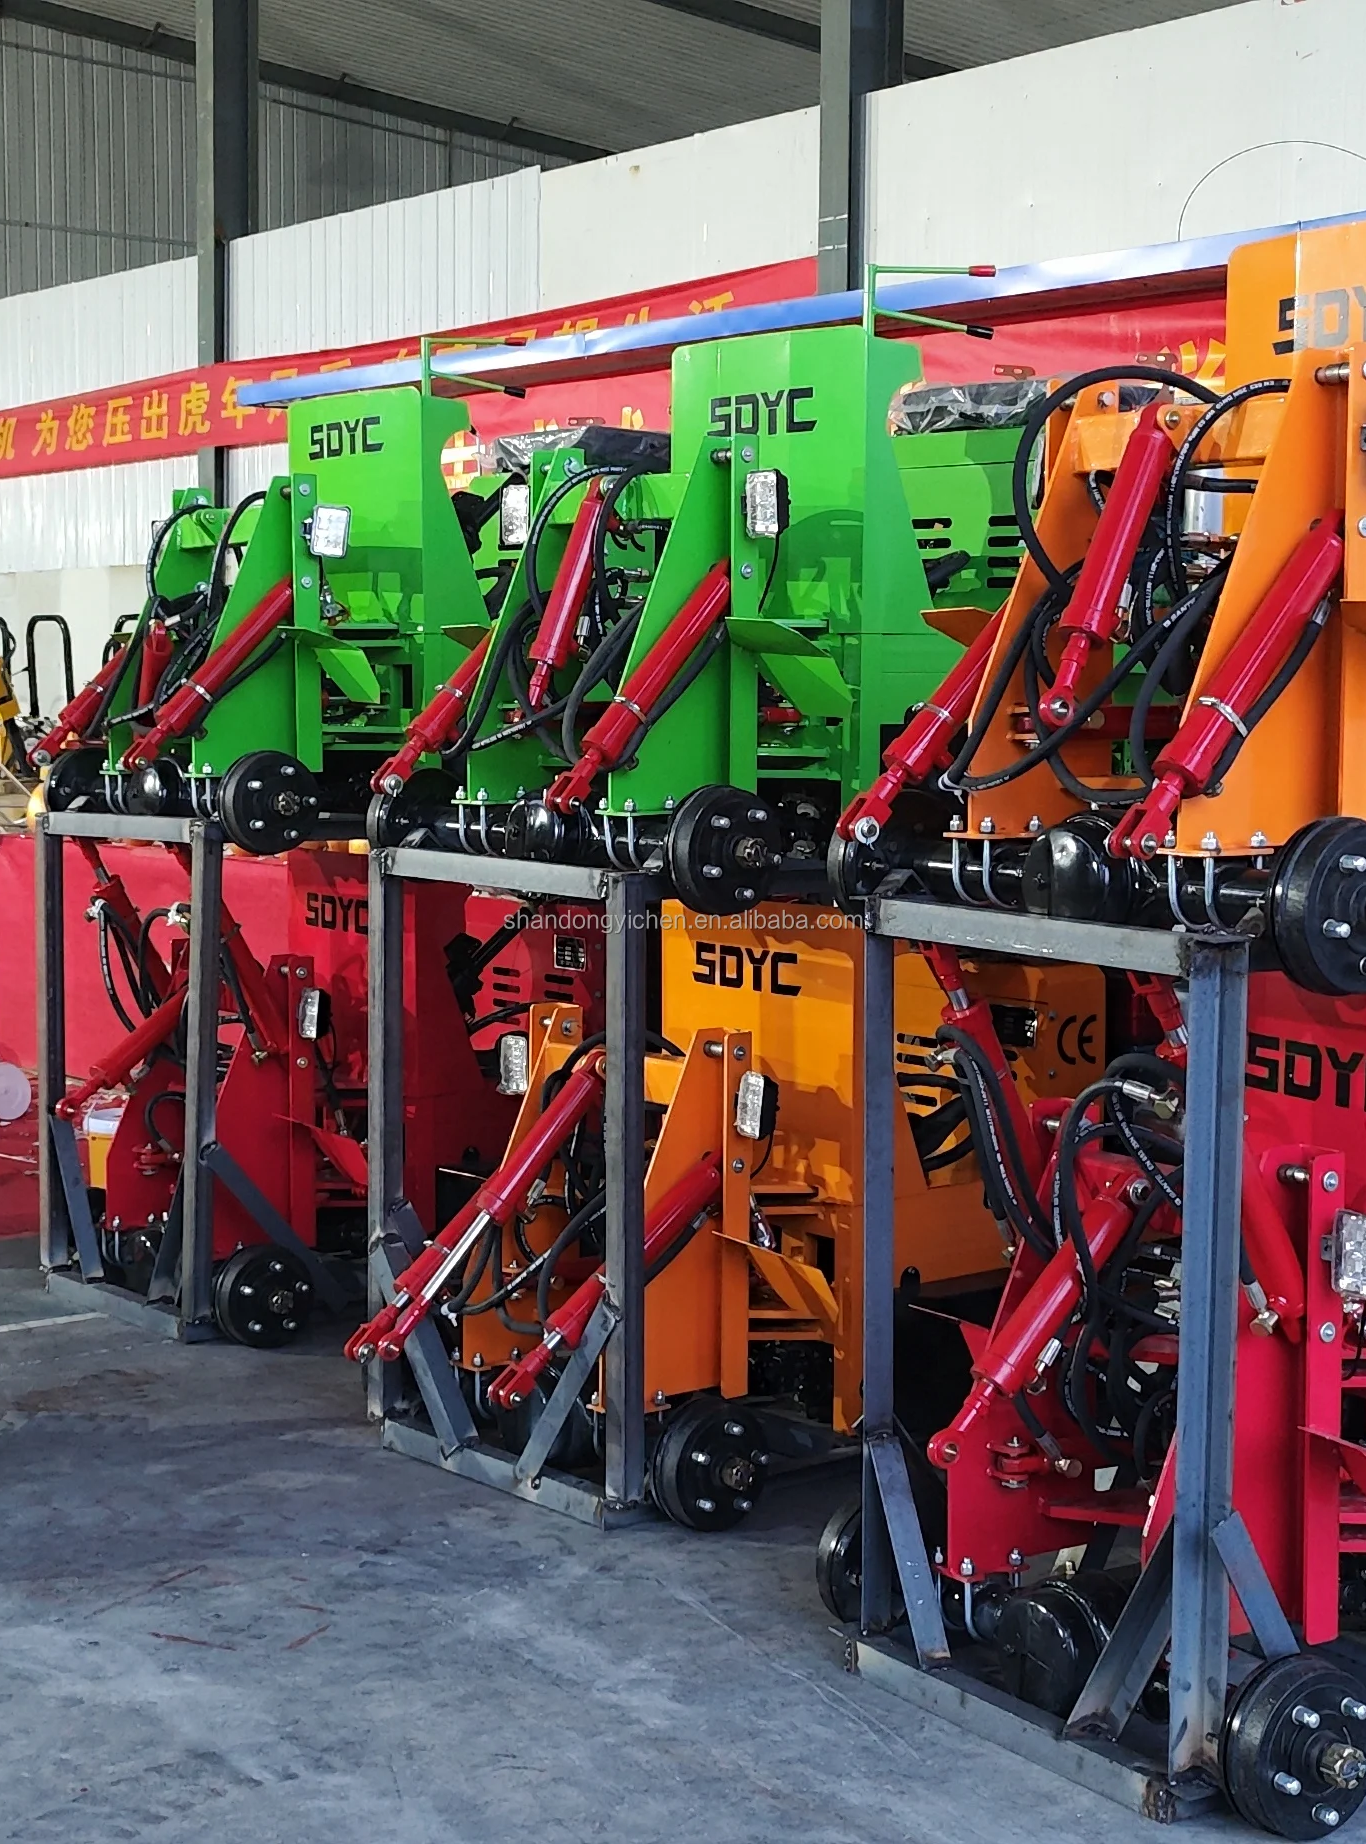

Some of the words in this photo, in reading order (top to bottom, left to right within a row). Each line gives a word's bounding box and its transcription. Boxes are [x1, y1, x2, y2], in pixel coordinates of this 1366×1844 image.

[708, 386, 818, 437] SDYC
[308, 415, 385, 462] SDYC
[692, 940, 803, 998] SDYC
[1056, 1013, 1098, 1066] CE
